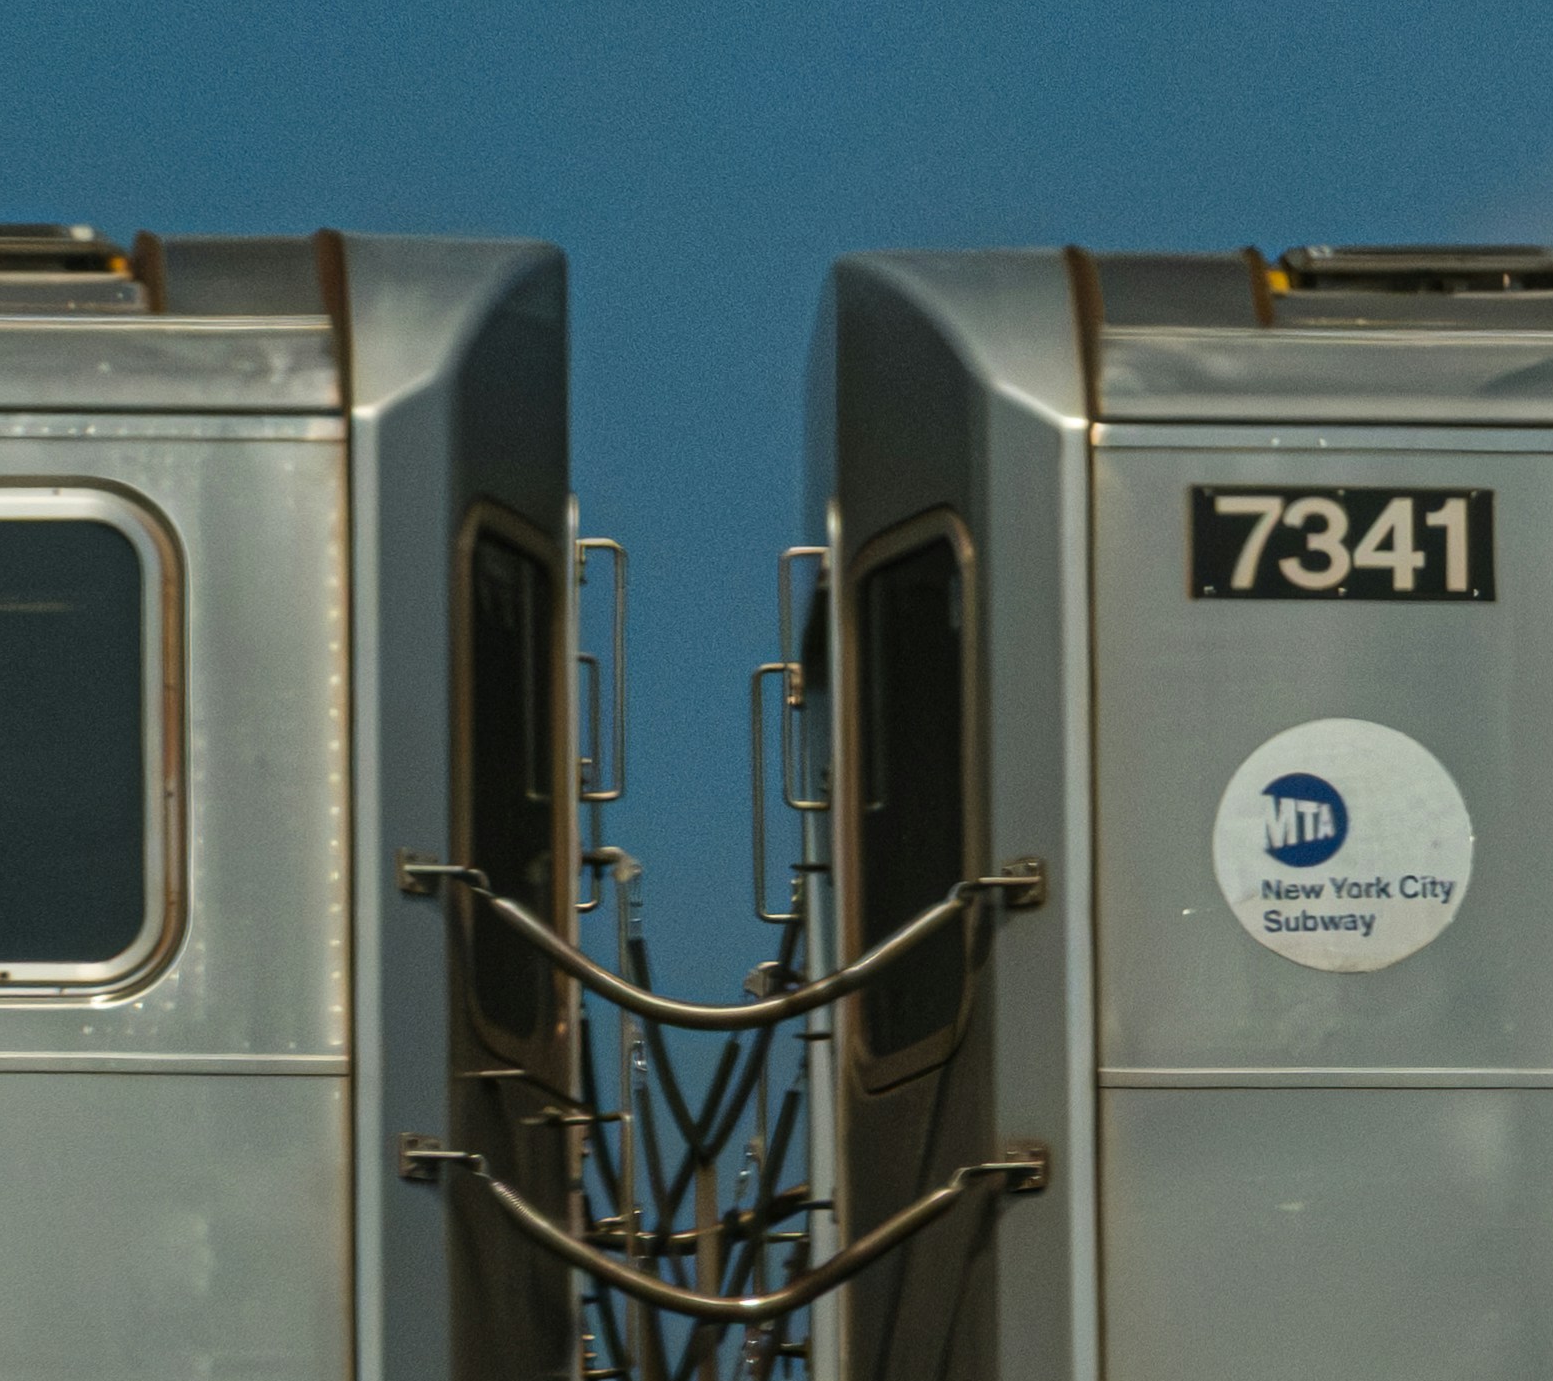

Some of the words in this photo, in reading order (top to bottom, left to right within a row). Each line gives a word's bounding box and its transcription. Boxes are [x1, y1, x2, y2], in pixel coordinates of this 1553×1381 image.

[1213, 494, 1469, 593] 7341
[1262, 792, 1337, 851] MTA
[1261, 878, 1325, 901] New
[1329, 876, 1392, 900] York
[1399, 874, 1456, 905] City
[1263, 908, 1377, 938] Subway
